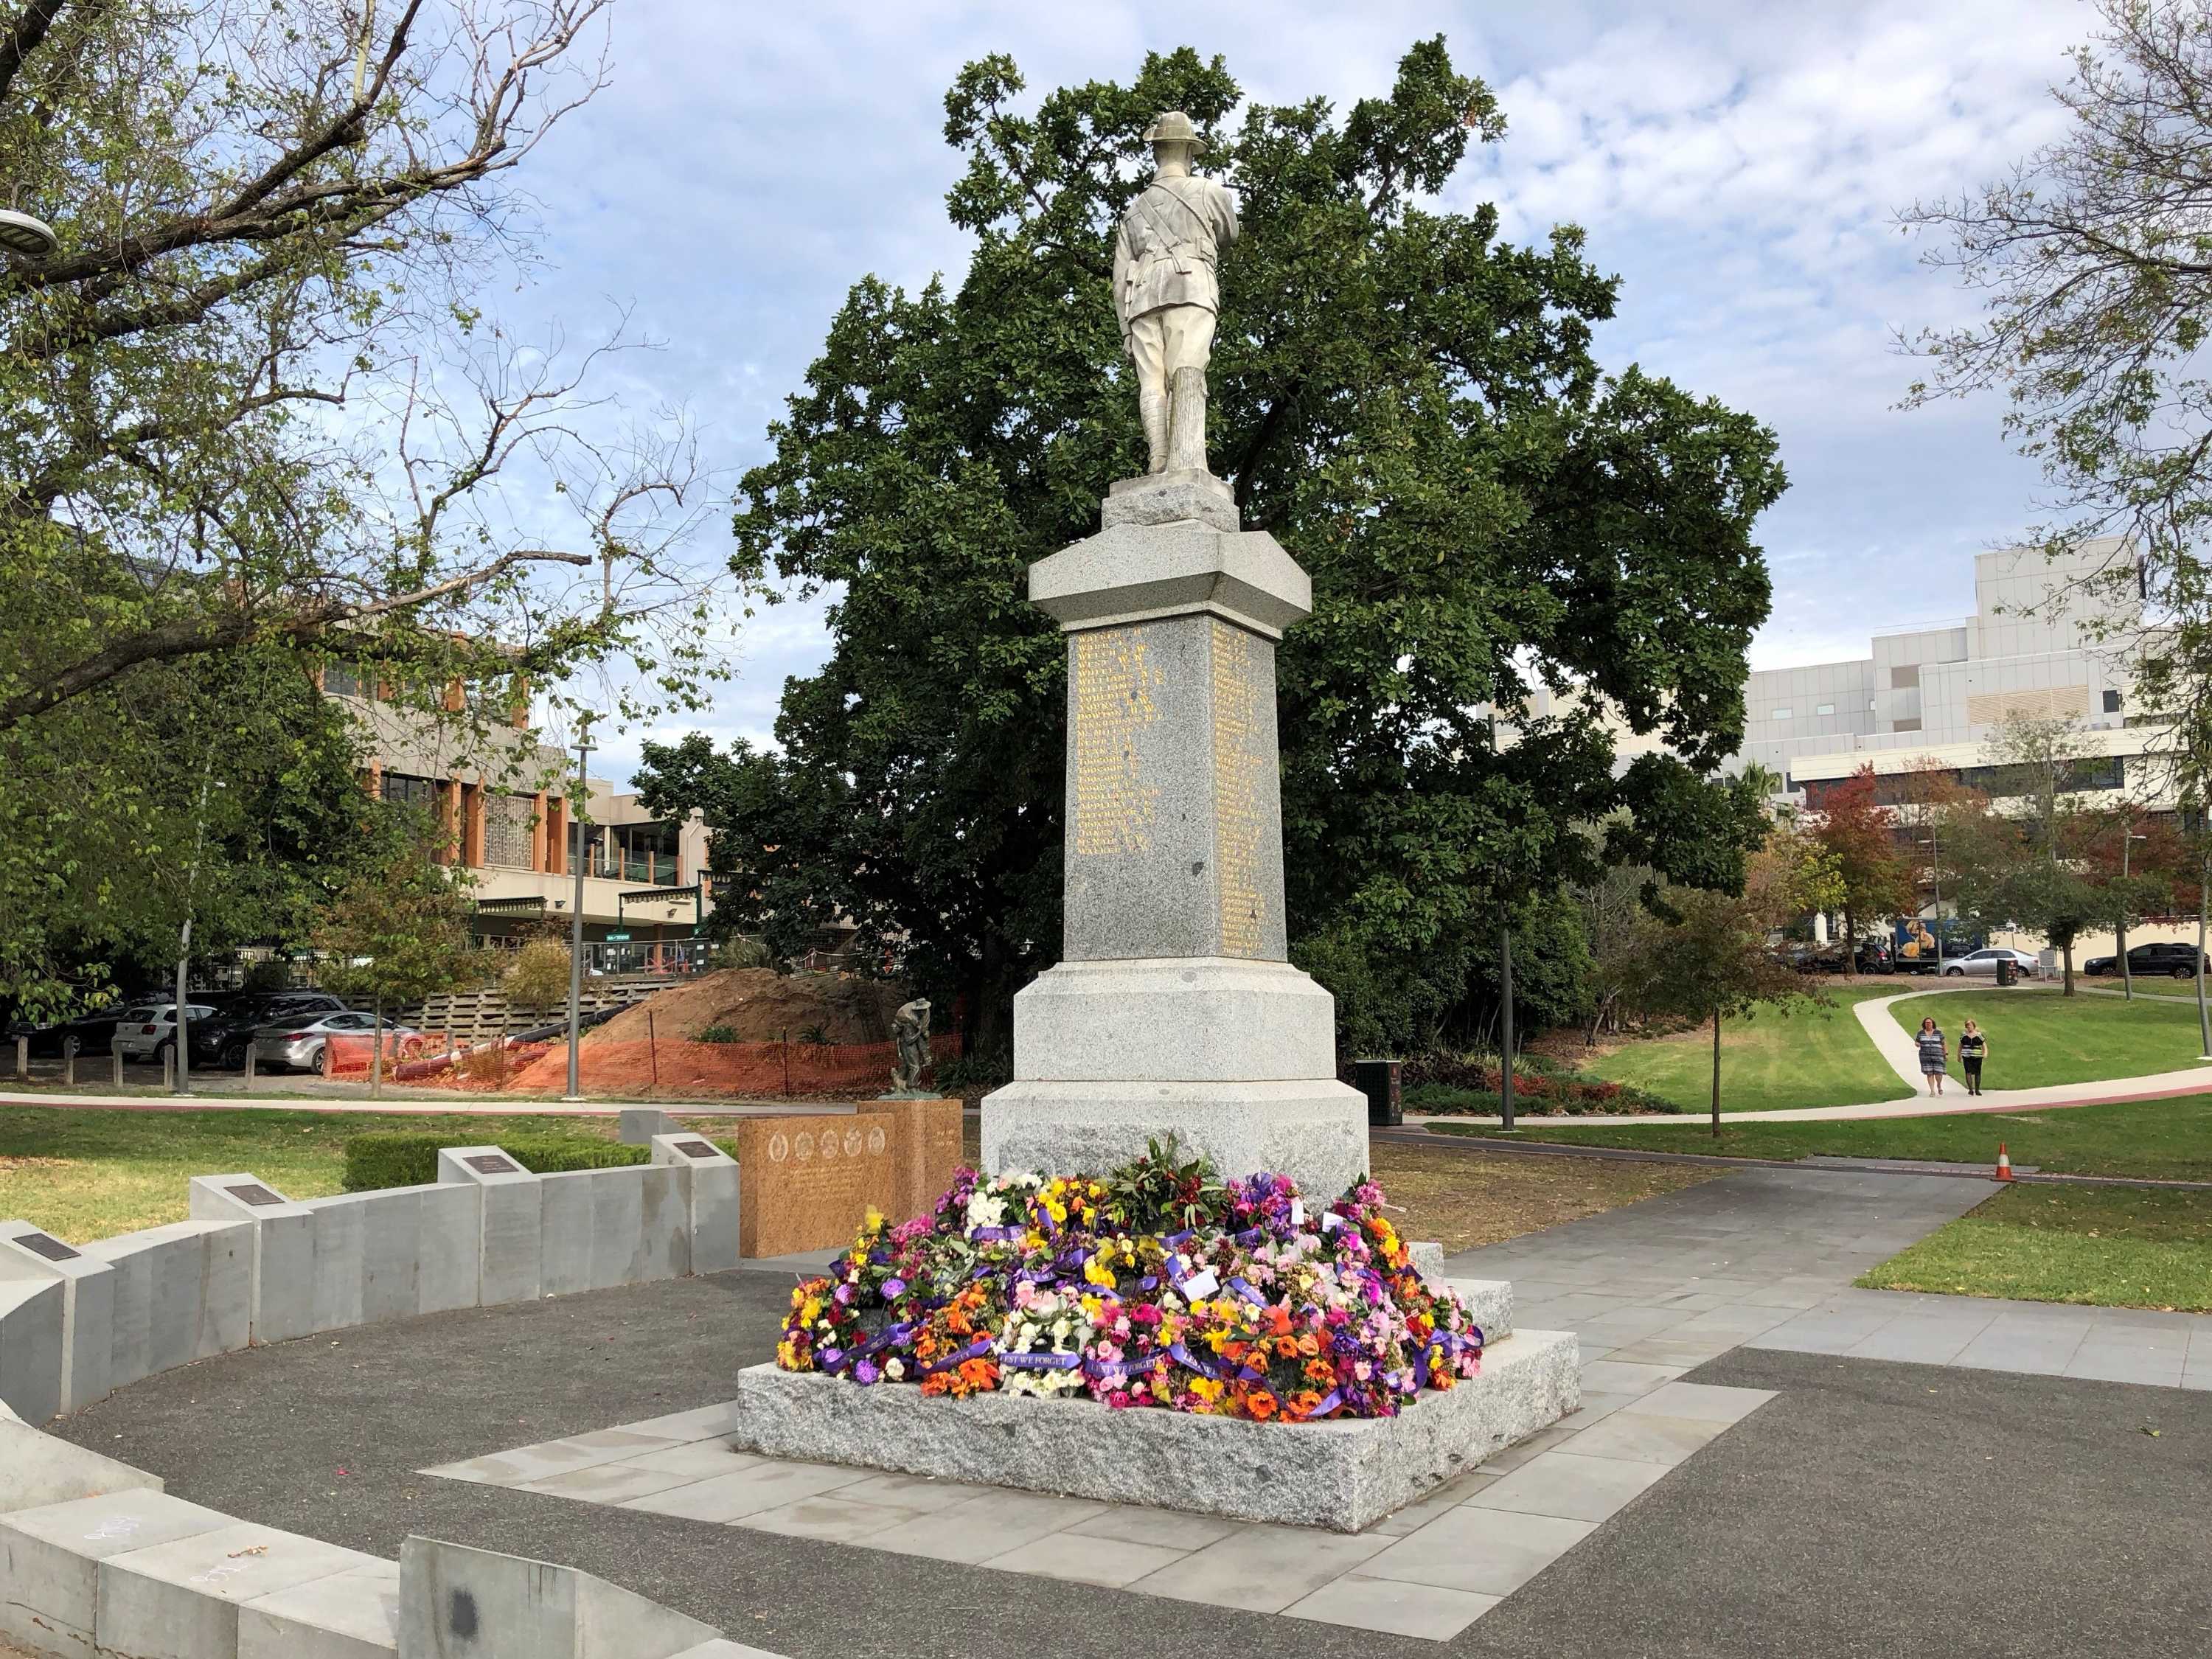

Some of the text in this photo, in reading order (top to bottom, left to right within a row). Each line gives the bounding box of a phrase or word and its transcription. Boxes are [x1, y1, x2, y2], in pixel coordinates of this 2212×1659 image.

[1000, 1355, 1067, 1366] LEST WE FORGET
